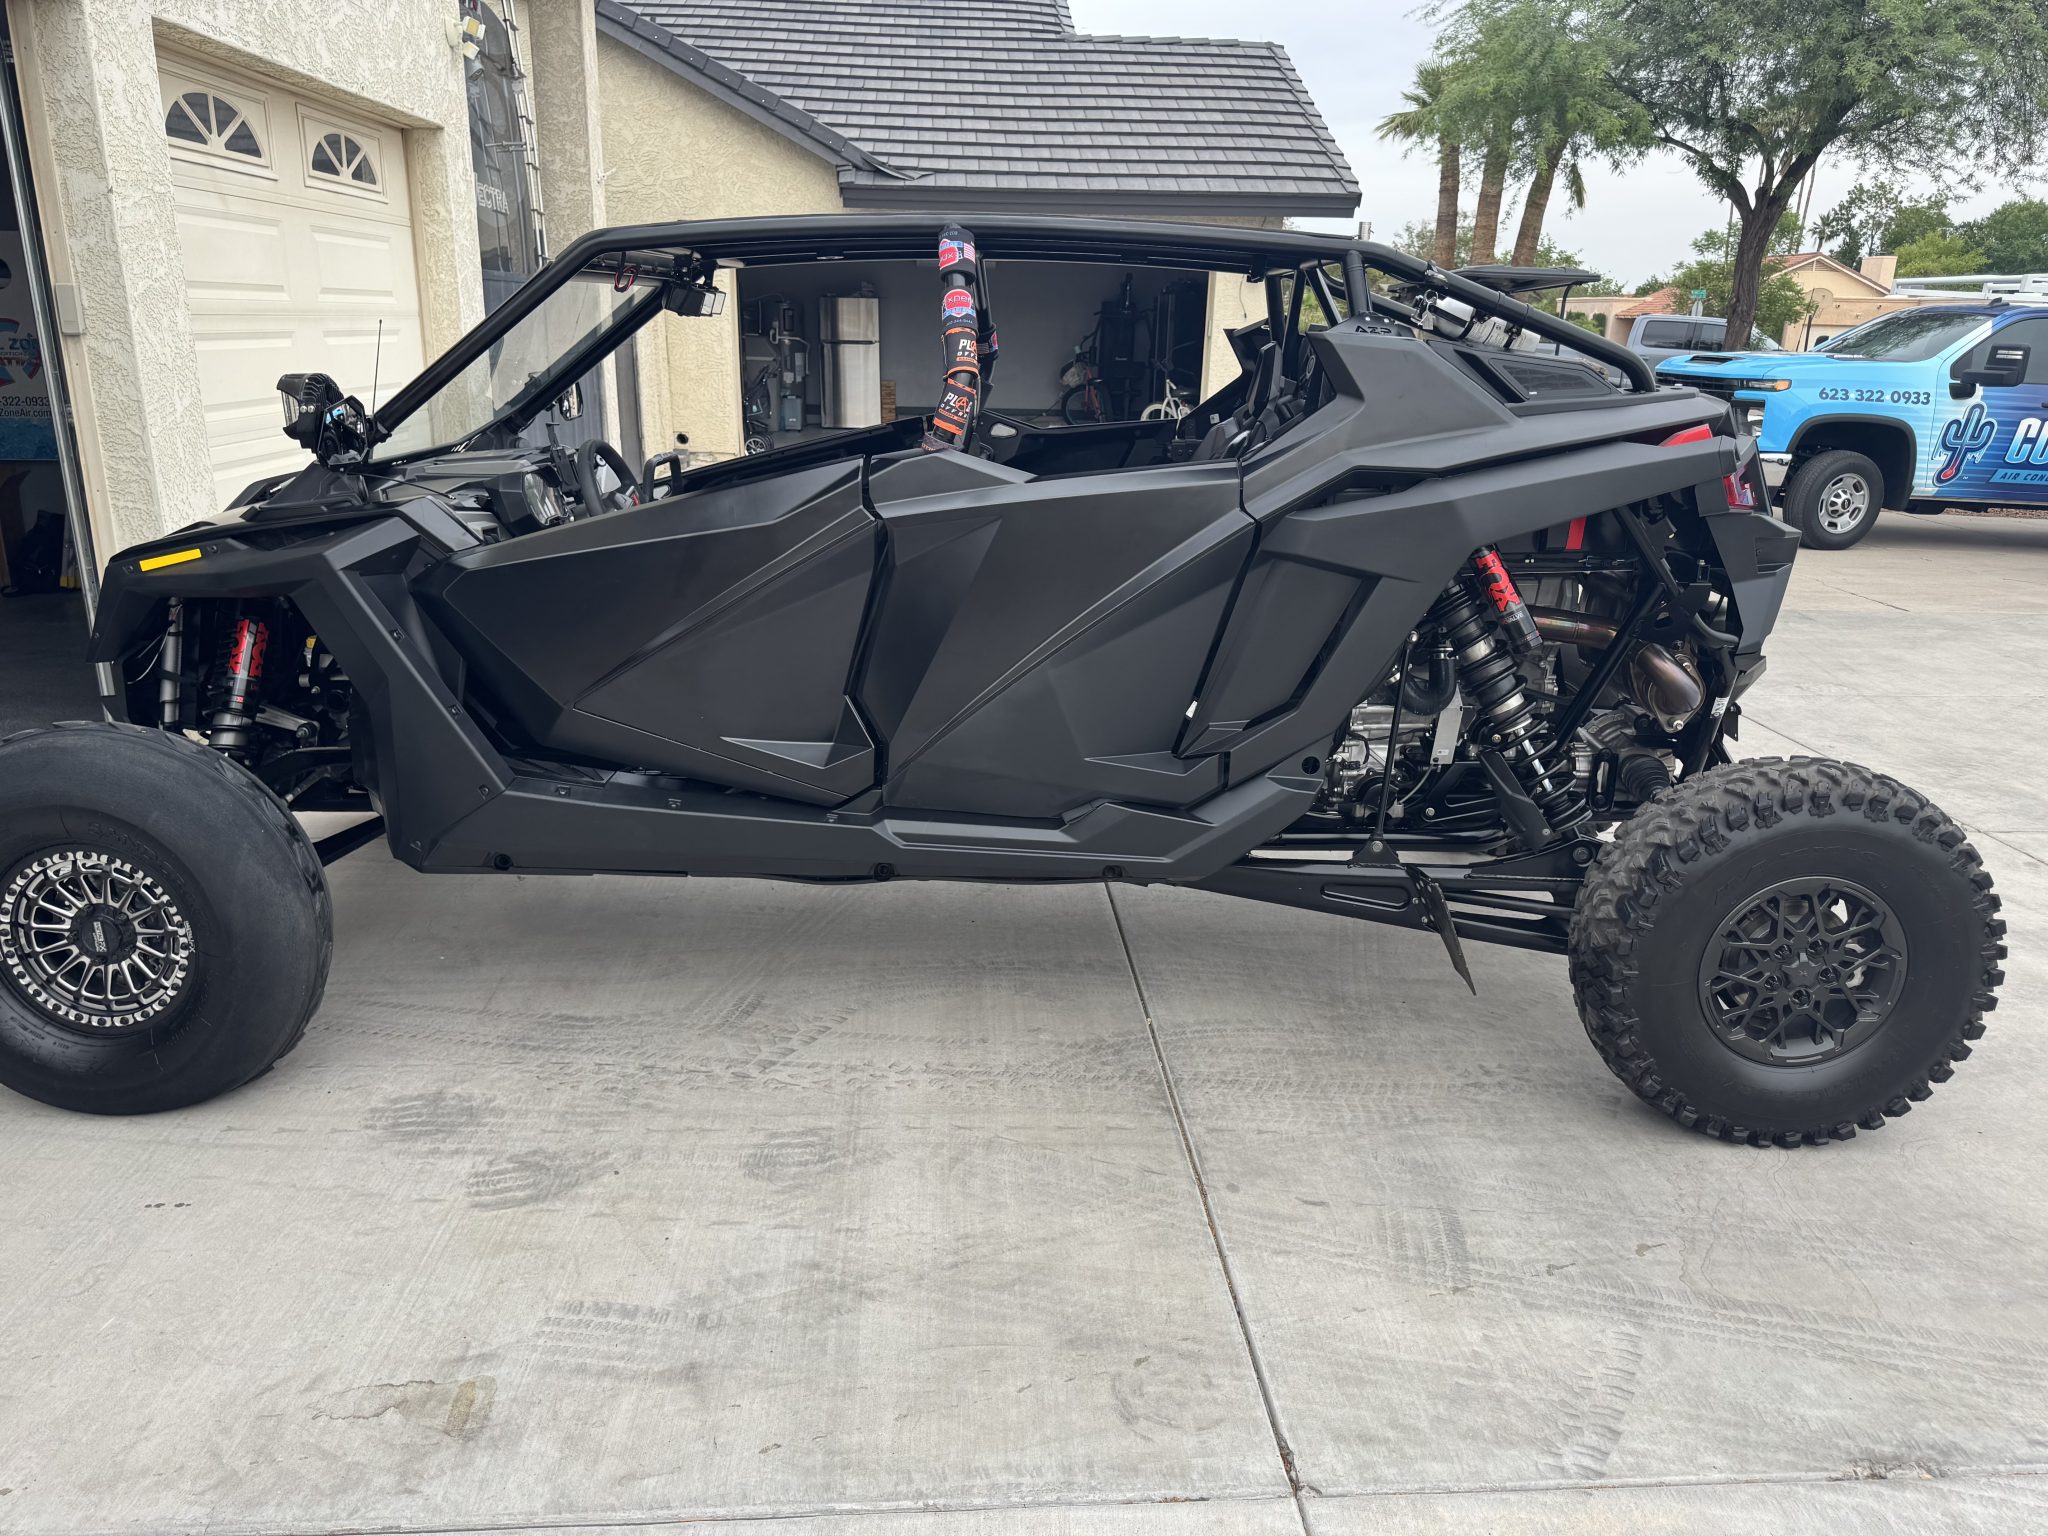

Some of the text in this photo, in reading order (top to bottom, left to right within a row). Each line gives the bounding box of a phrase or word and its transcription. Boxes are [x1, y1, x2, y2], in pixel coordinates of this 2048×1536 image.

[475, 174, 510, 215] ECTRA
[1819, 387, 1931, 405] 623 322 0933
[2000, 472, 2048, 482] AIR CON
[1475, 550, 1520, 613] FOX
